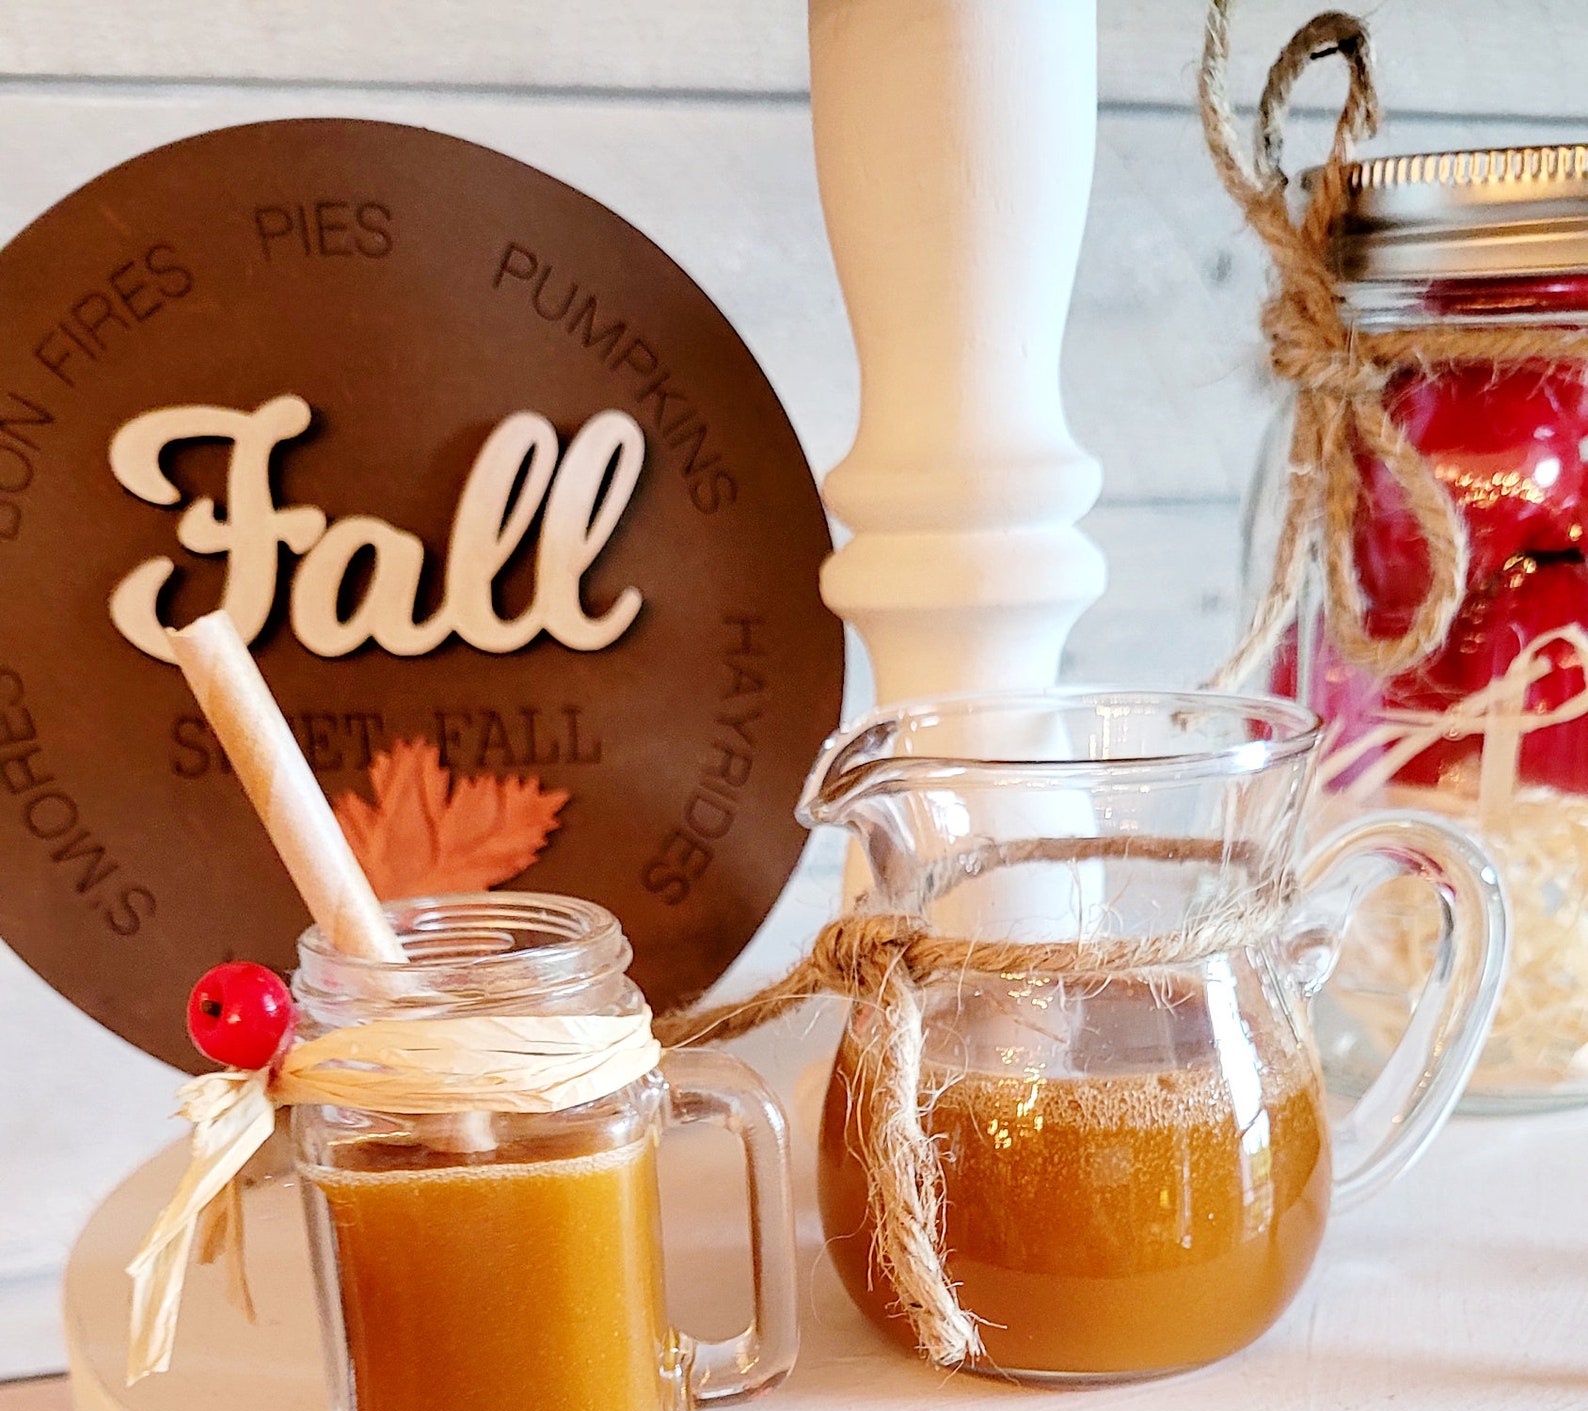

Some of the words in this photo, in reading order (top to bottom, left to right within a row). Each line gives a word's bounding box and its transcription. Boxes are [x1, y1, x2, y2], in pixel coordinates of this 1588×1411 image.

[34, 243, 194, 389] FIRES
[253, 200, 394, 262] PIES
[492, 240, 739, 517] PUMPKINS
[109, 394, 646, 664] Fall
[170, 712, 385, 780] SET
[434, 703, 601, 770] FALL
[641, 614, 768, 907] HAYRIDES
